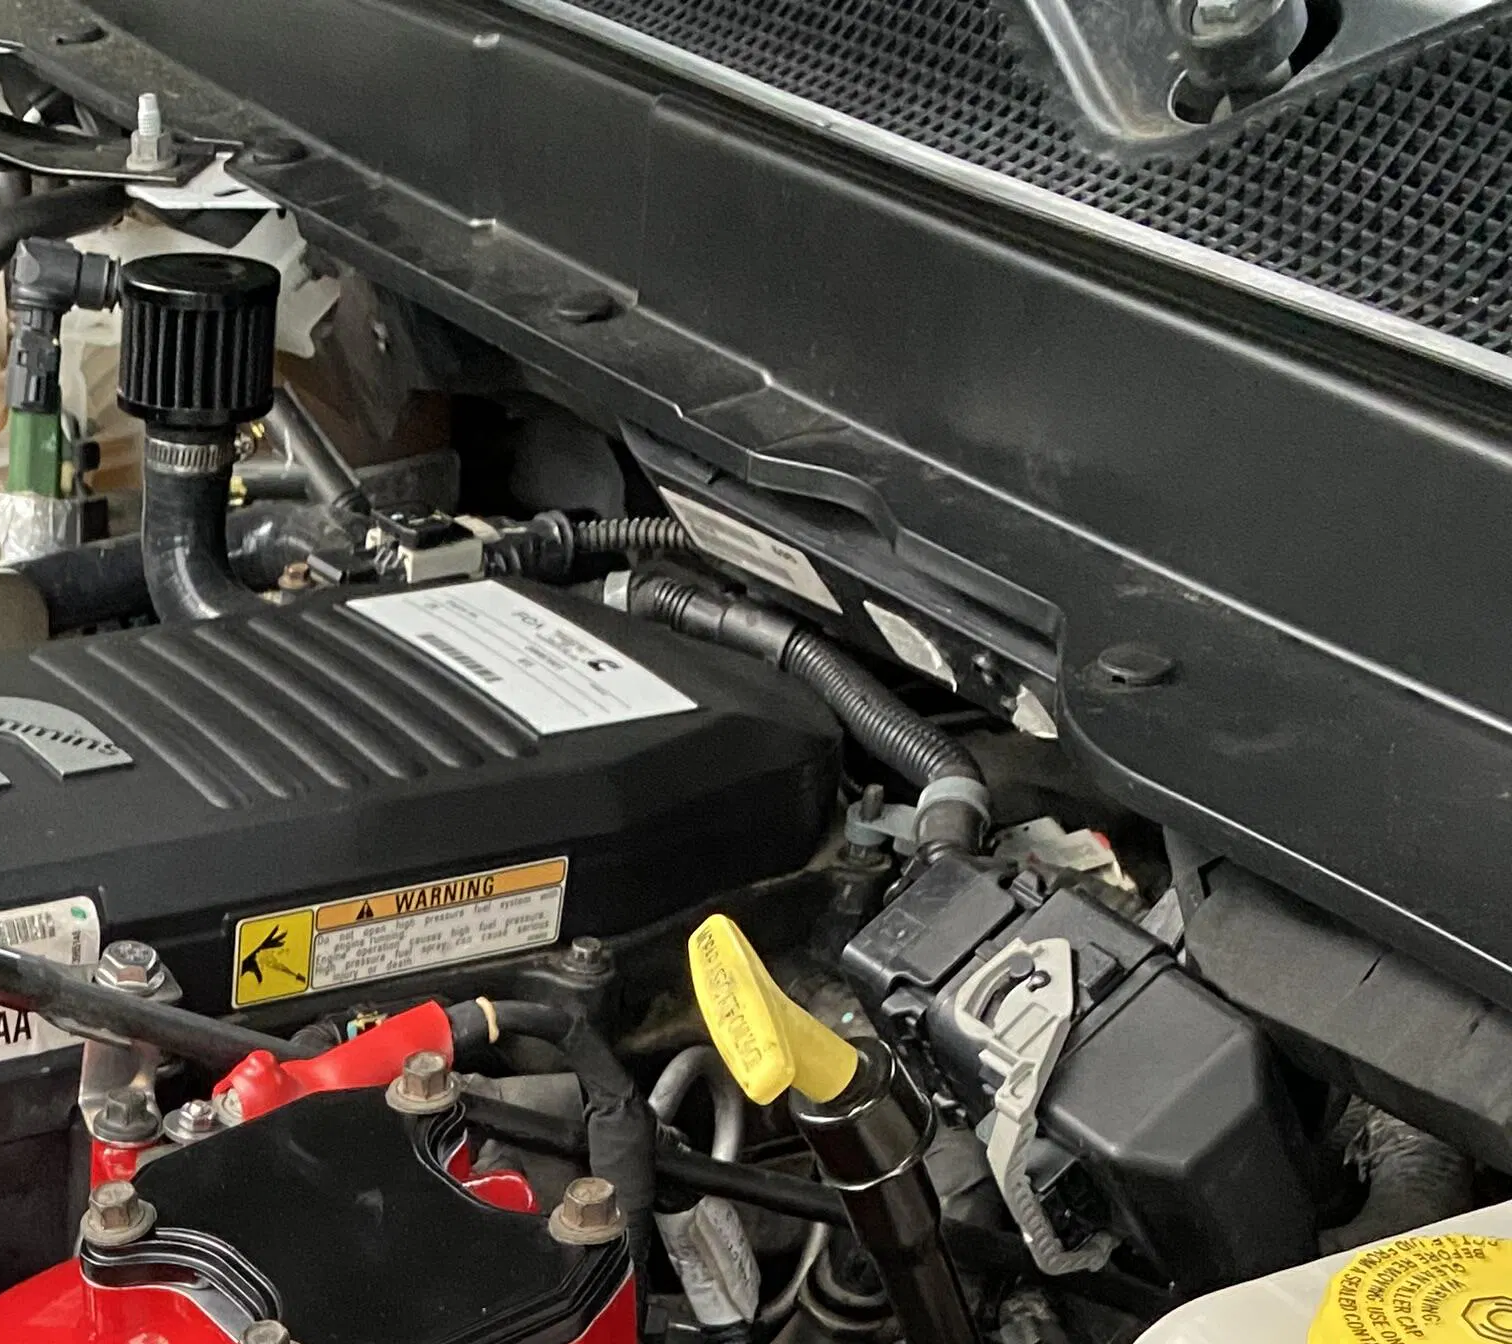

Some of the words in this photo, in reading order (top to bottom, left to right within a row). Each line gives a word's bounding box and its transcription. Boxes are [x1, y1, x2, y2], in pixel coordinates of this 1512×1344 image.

[395, 876, 495, 914] WARNING
[1359, 1247, 1399, 1270] FROM
[1414, 1247, 1487, 1265] BEFORE
[1412, 1262, 1466, 1287] CLEAN
[1338, 1273, 1362, 1312] SEALED
[1392, 1281, 1422, 1313] FILLER
[1367, 1306, 1388, 1327] USE
[1396, 1315, 1425, 1339] CAP
